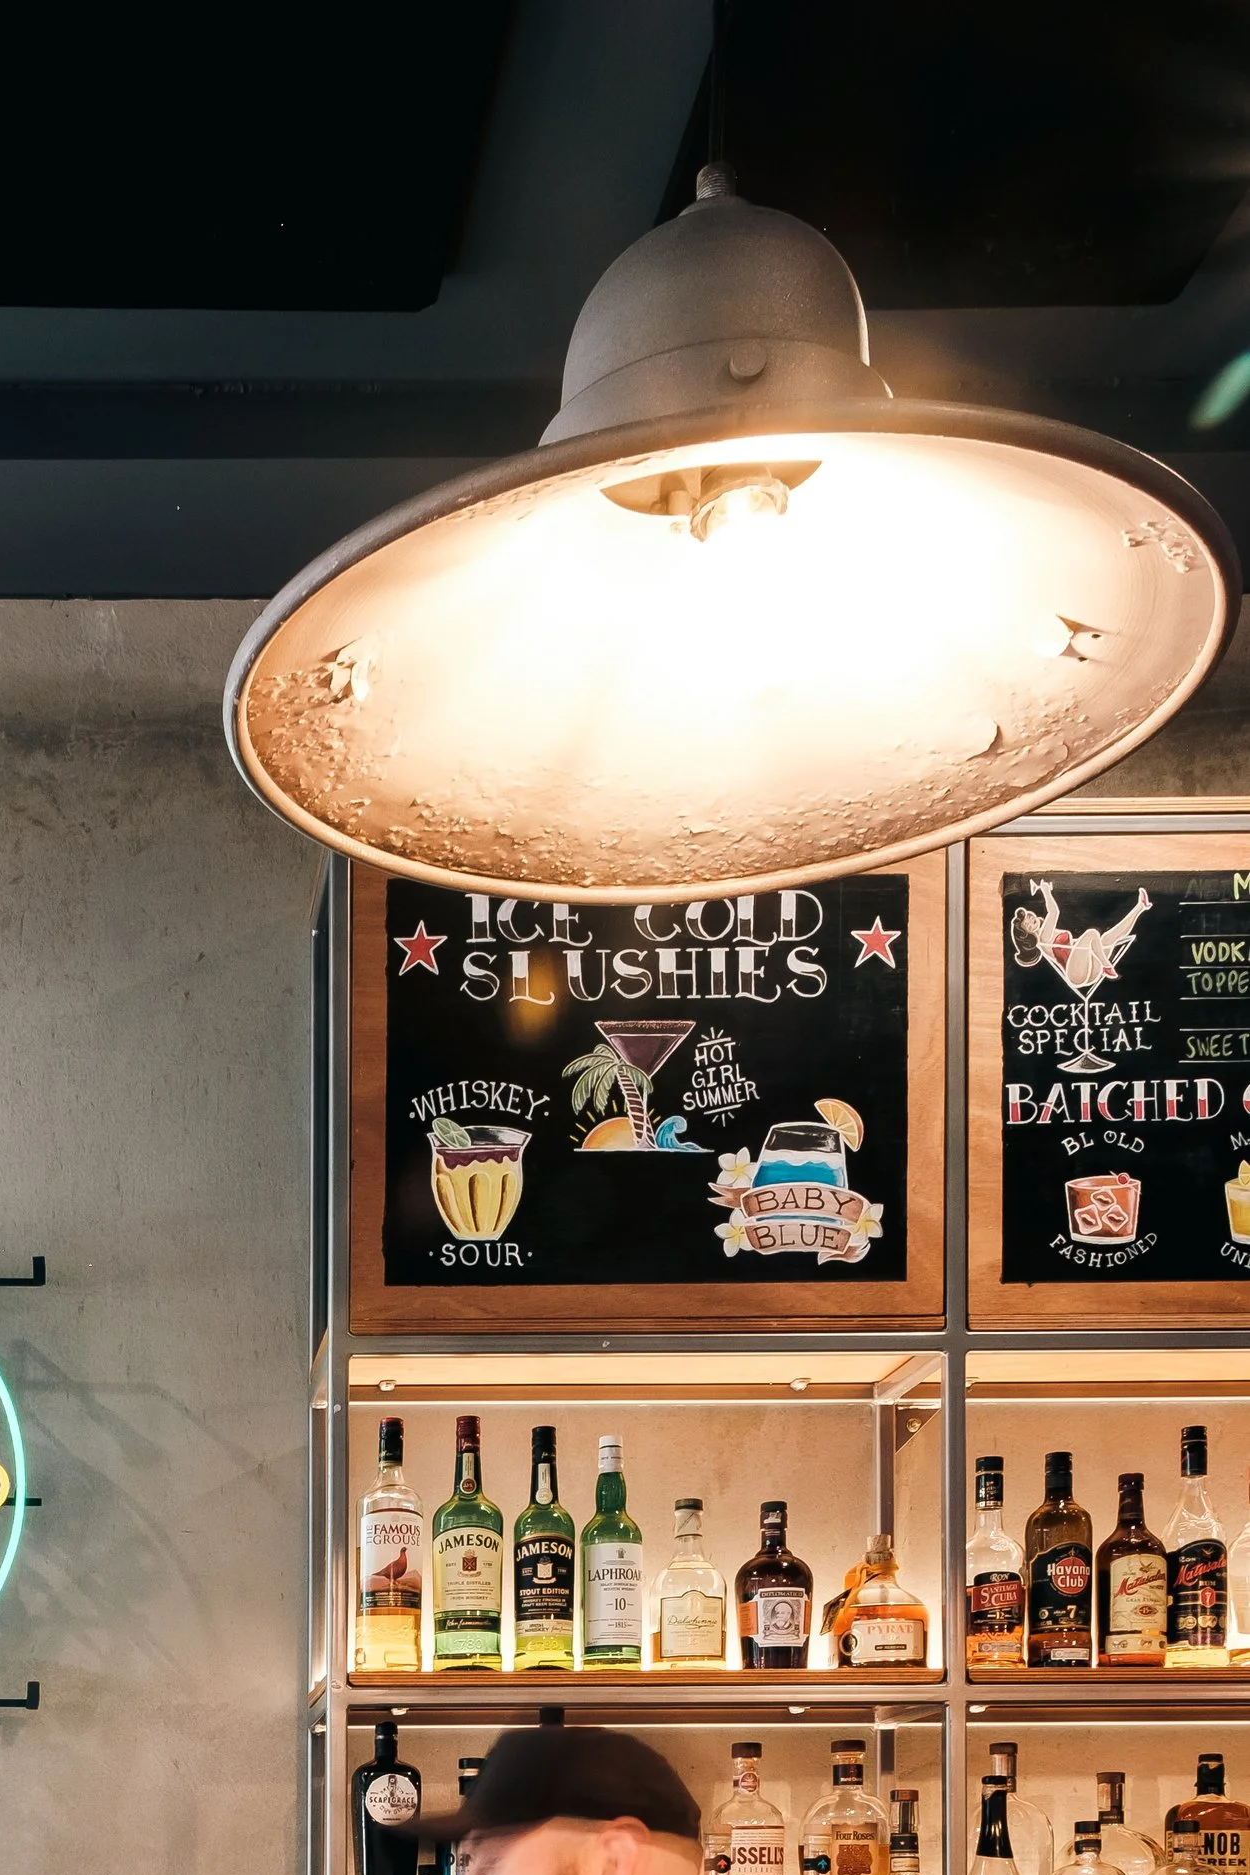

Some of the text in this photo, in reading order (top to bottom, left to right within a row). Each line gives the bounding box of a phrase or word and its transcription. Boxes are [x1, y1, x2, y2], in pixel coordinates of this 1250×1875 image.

[466, 890, 824, 945] ICE COLD
[1191, 941, 1250, 964] VODK
[460, 946, 828, 1005] SLUSHIES
[1007, 1001, 1161, 1029] COCKTAIL
[1017, 1027, 1153, 1055] SPECIAL
[694, 1040, 737, 1068] HOT
[691, 1064, 746, 1089] GIRL
[683, 1081, 760, 1113] SUMMER
[1005, 1078, 1225, 1125] BATCHED
[1103, 1130, 1145, 1153] OLD
[754, 1187, 858, 1217] BABY
[754, 1224, 842, 1253] BLUE
[1050, 1232, 1158, 1268] FASHIONED
[440, 1243, 525, 1267] SOUR
[373, 1535, 420, 1546] GROUSE
[374, 1523, 421, 1537] FAMOUS
[438, 1533, 500, 1554] JAMESON
[515, 1541, 573, 1562] JAMESON
[1047, 1562, 1090, 1576] Havana
[519, 1587, 570, 1596] STOUT EDITION
[1057, 1575, 1084, 1588] Club
[614, 1597, 627, 1611] 10
[980, 1583, 1018, 1604] SANTIAGO
[991, 1591, 1018, 1606] CUBA
[1067, 1605, 1077, 1619] 7
[835, 1830, 875, 1840] Four Roses
